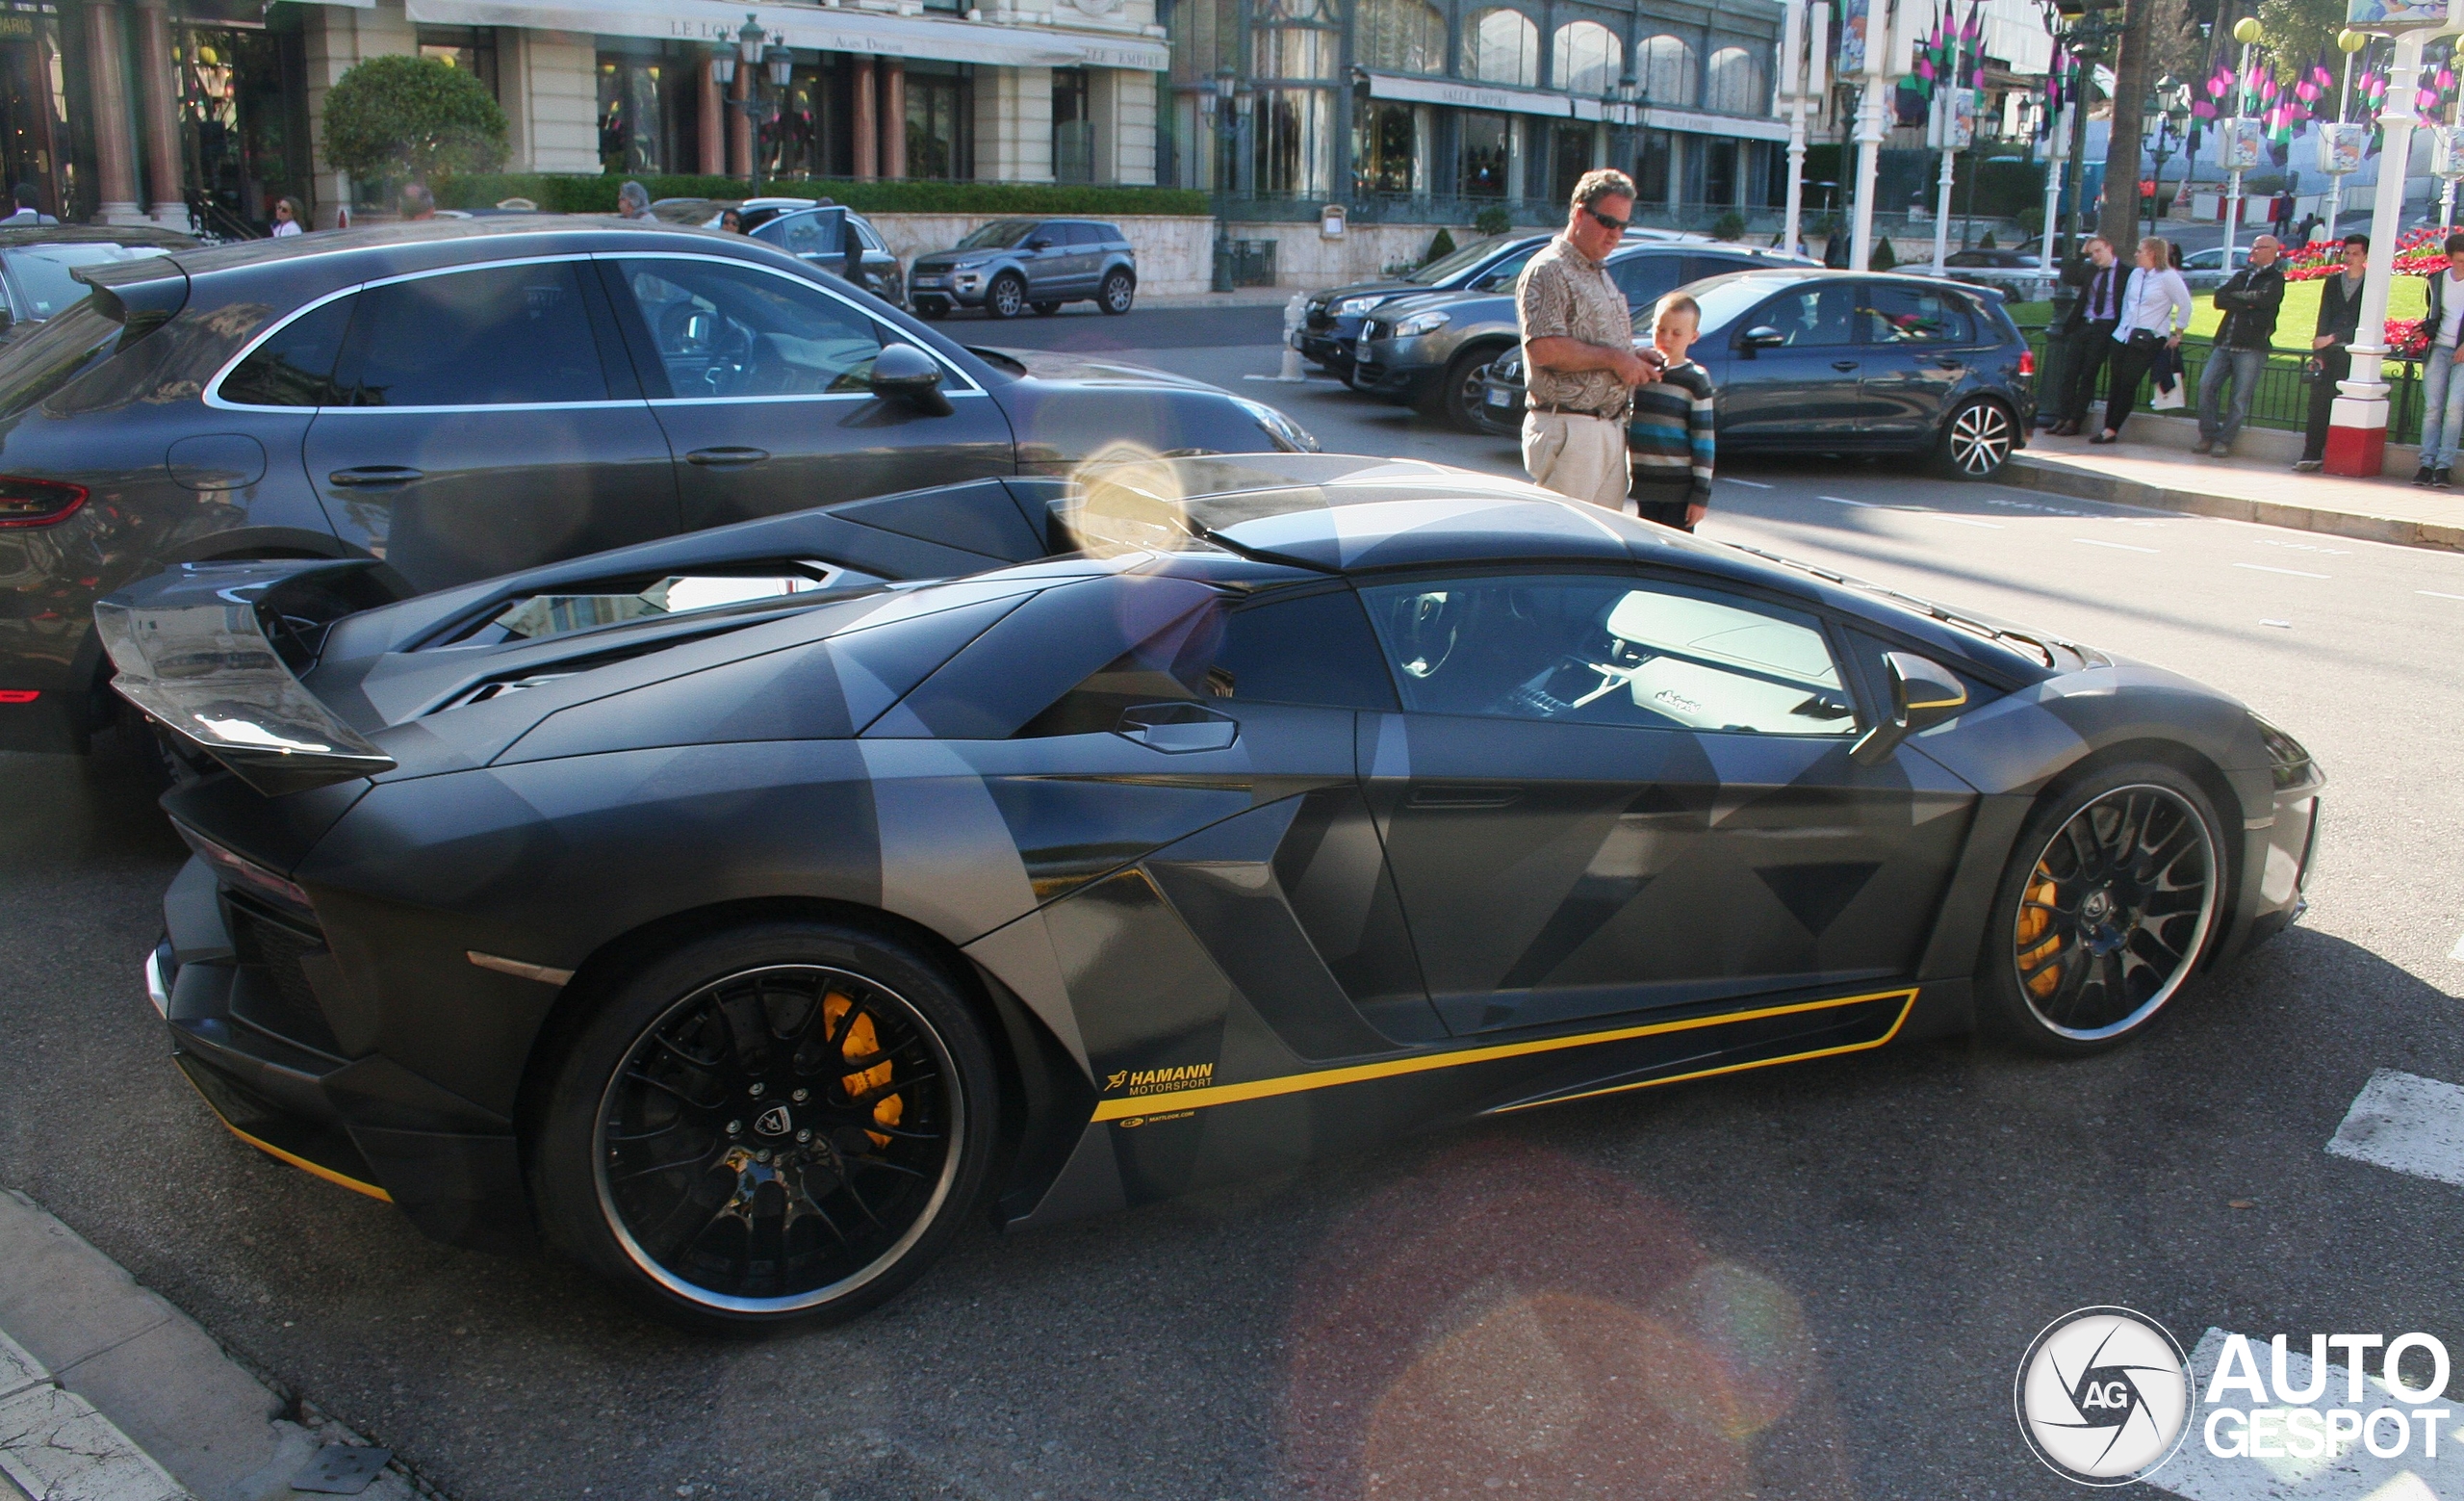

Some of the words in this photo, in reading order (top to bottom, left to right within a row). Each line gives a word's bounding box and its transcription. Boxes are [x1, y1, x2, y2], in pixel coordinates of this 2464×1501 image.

[671, 20, 692, 36] LE
[1130, 1062, 1214, 1086] HAMANN
[1129, 1076, 1213, 1097] MOTORSPORT
